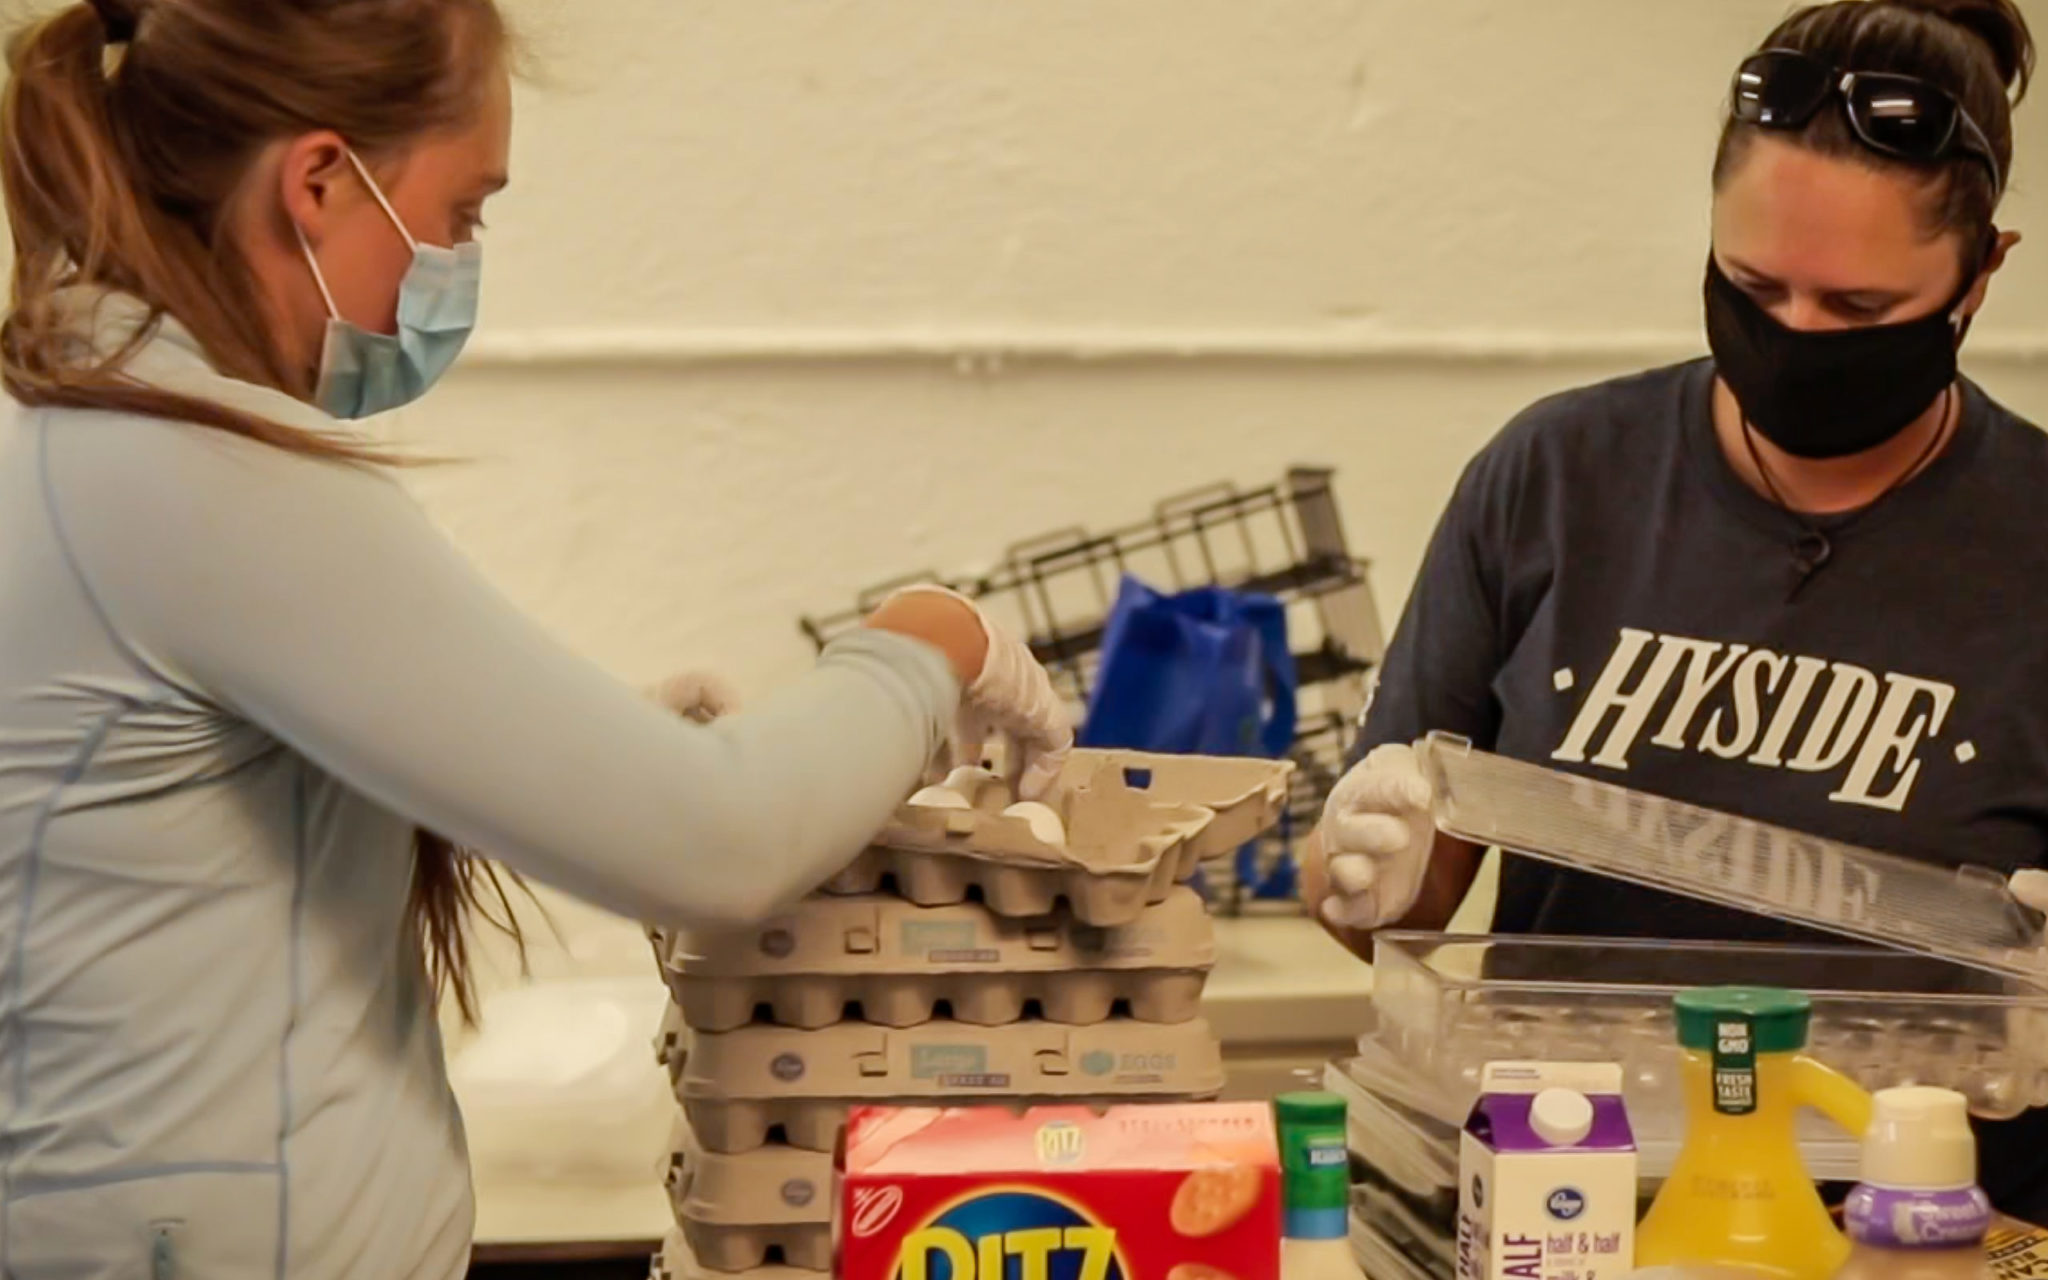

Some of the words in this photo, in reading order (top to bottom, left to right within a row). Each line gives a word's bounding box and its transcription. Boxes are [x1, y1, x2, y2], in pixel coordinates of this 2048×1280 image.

[1551, 627, 1955, 811] HYSIDE
[1547, 1233, 1573, 1253] half
[1578, 1232, 1589, 1254] &
[1594, 1233, 1620, 1253] half
